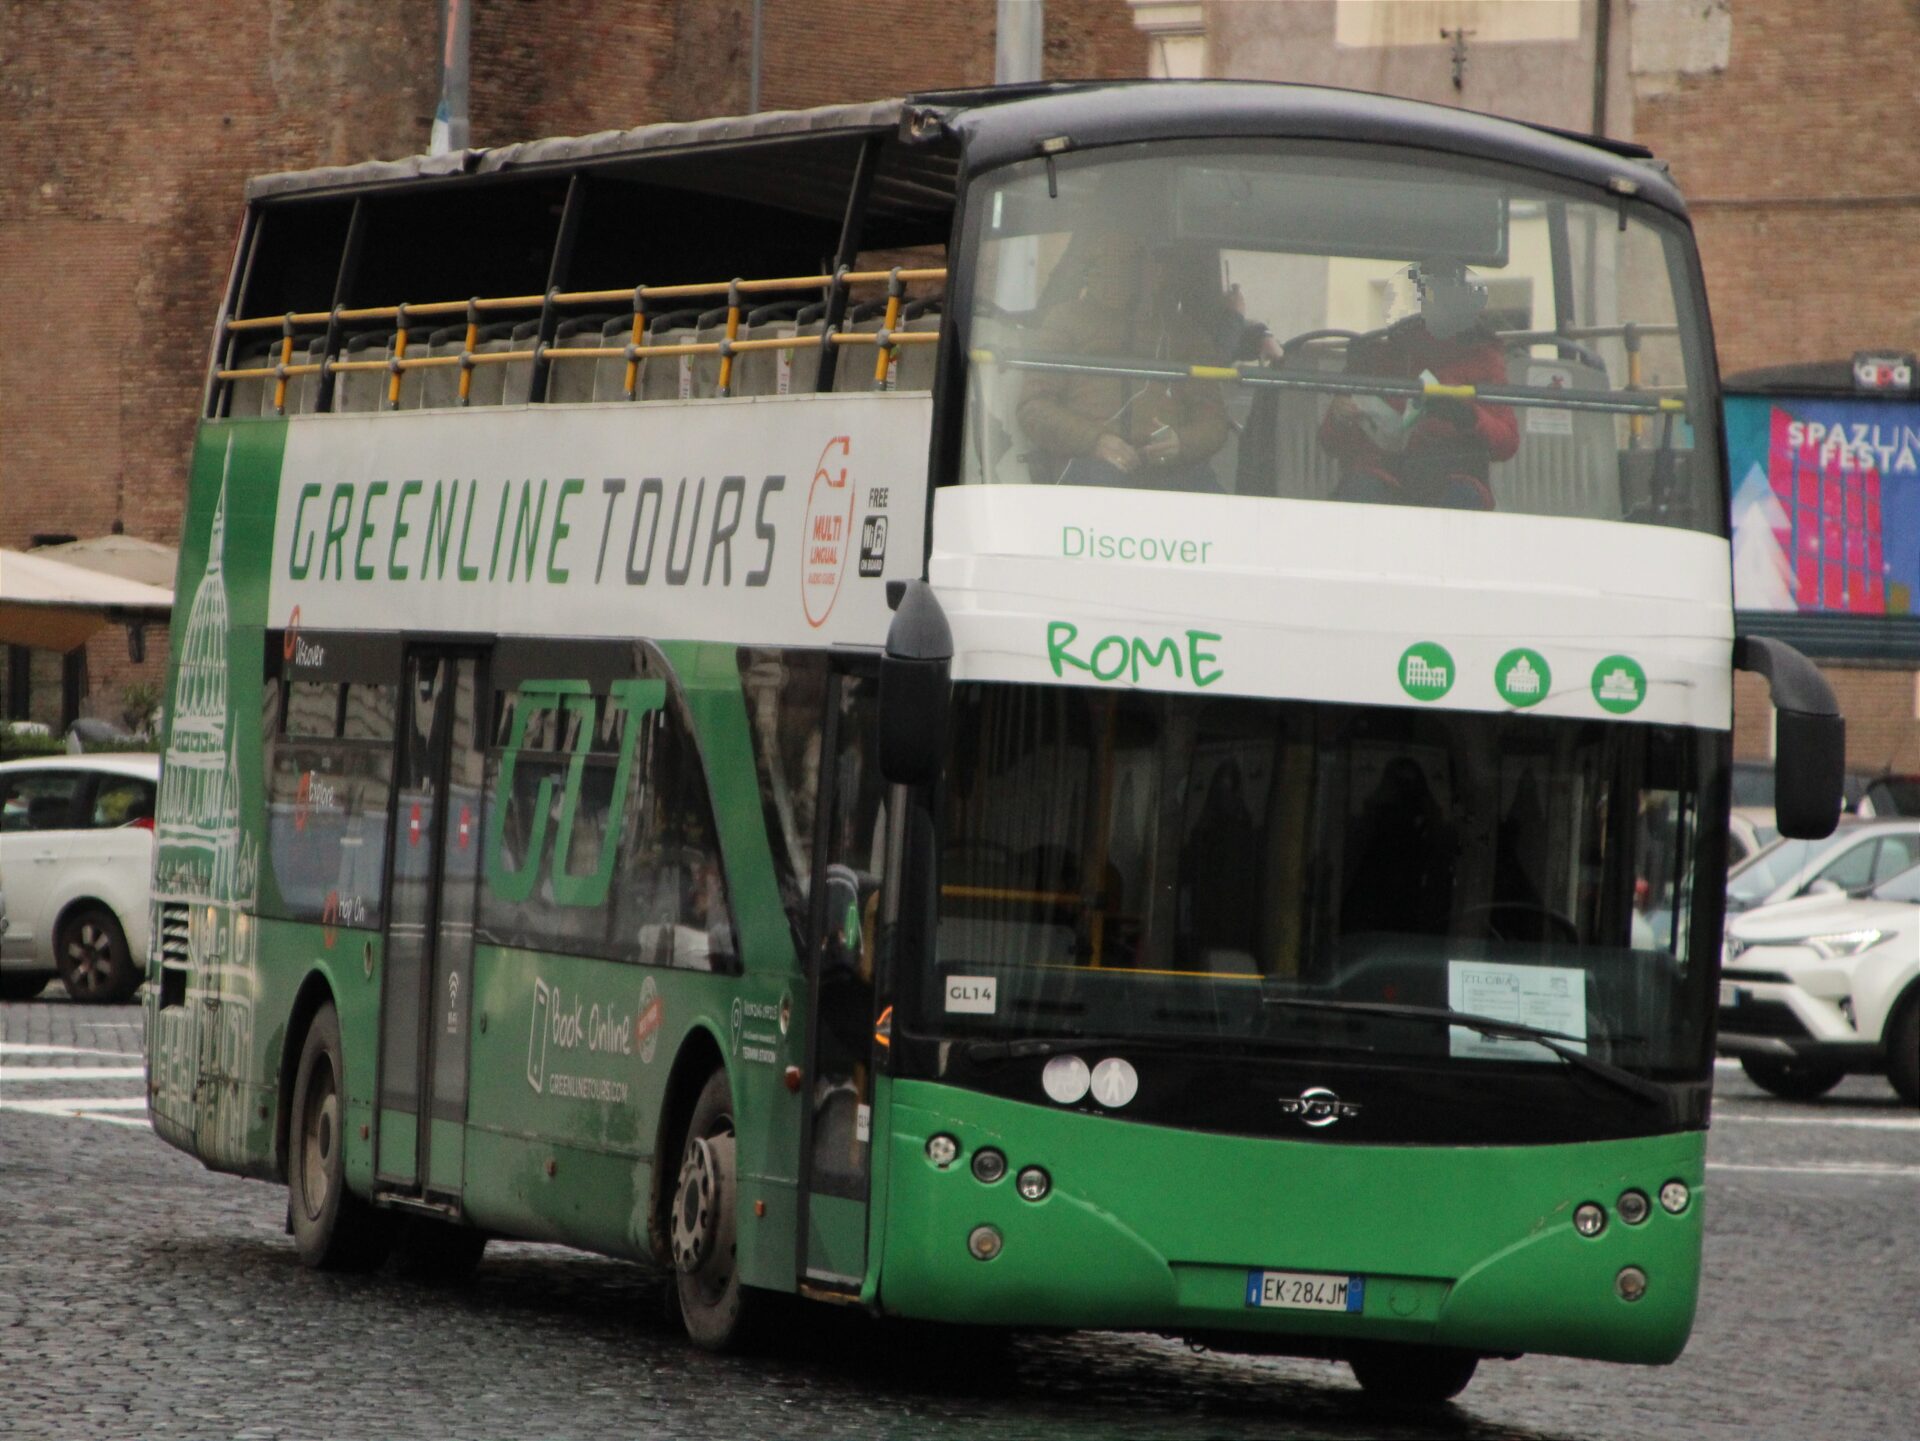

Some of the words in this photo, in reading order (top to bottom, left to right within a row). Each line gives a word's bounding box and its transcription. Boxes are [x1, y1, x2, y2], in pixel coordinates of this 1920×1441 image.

[1819, 443, 1917, 473] FESTA
[868, 487, 889, 508] FREE
[287, 478, 585, 584] GREENLINE
[594, 475, 786, 588] TOURS
[813, 515, 842, 540] MULTI
[810, 547, 837, 564] LINGUAL
[1062, 526, 1213, 564] Discover
[1047, 621, 1224, 687] ROME
[950, 986, 992, 1000] GL14
[552, 986, 583, 1048] Book
[588, 1002, 631, 1055] Online
